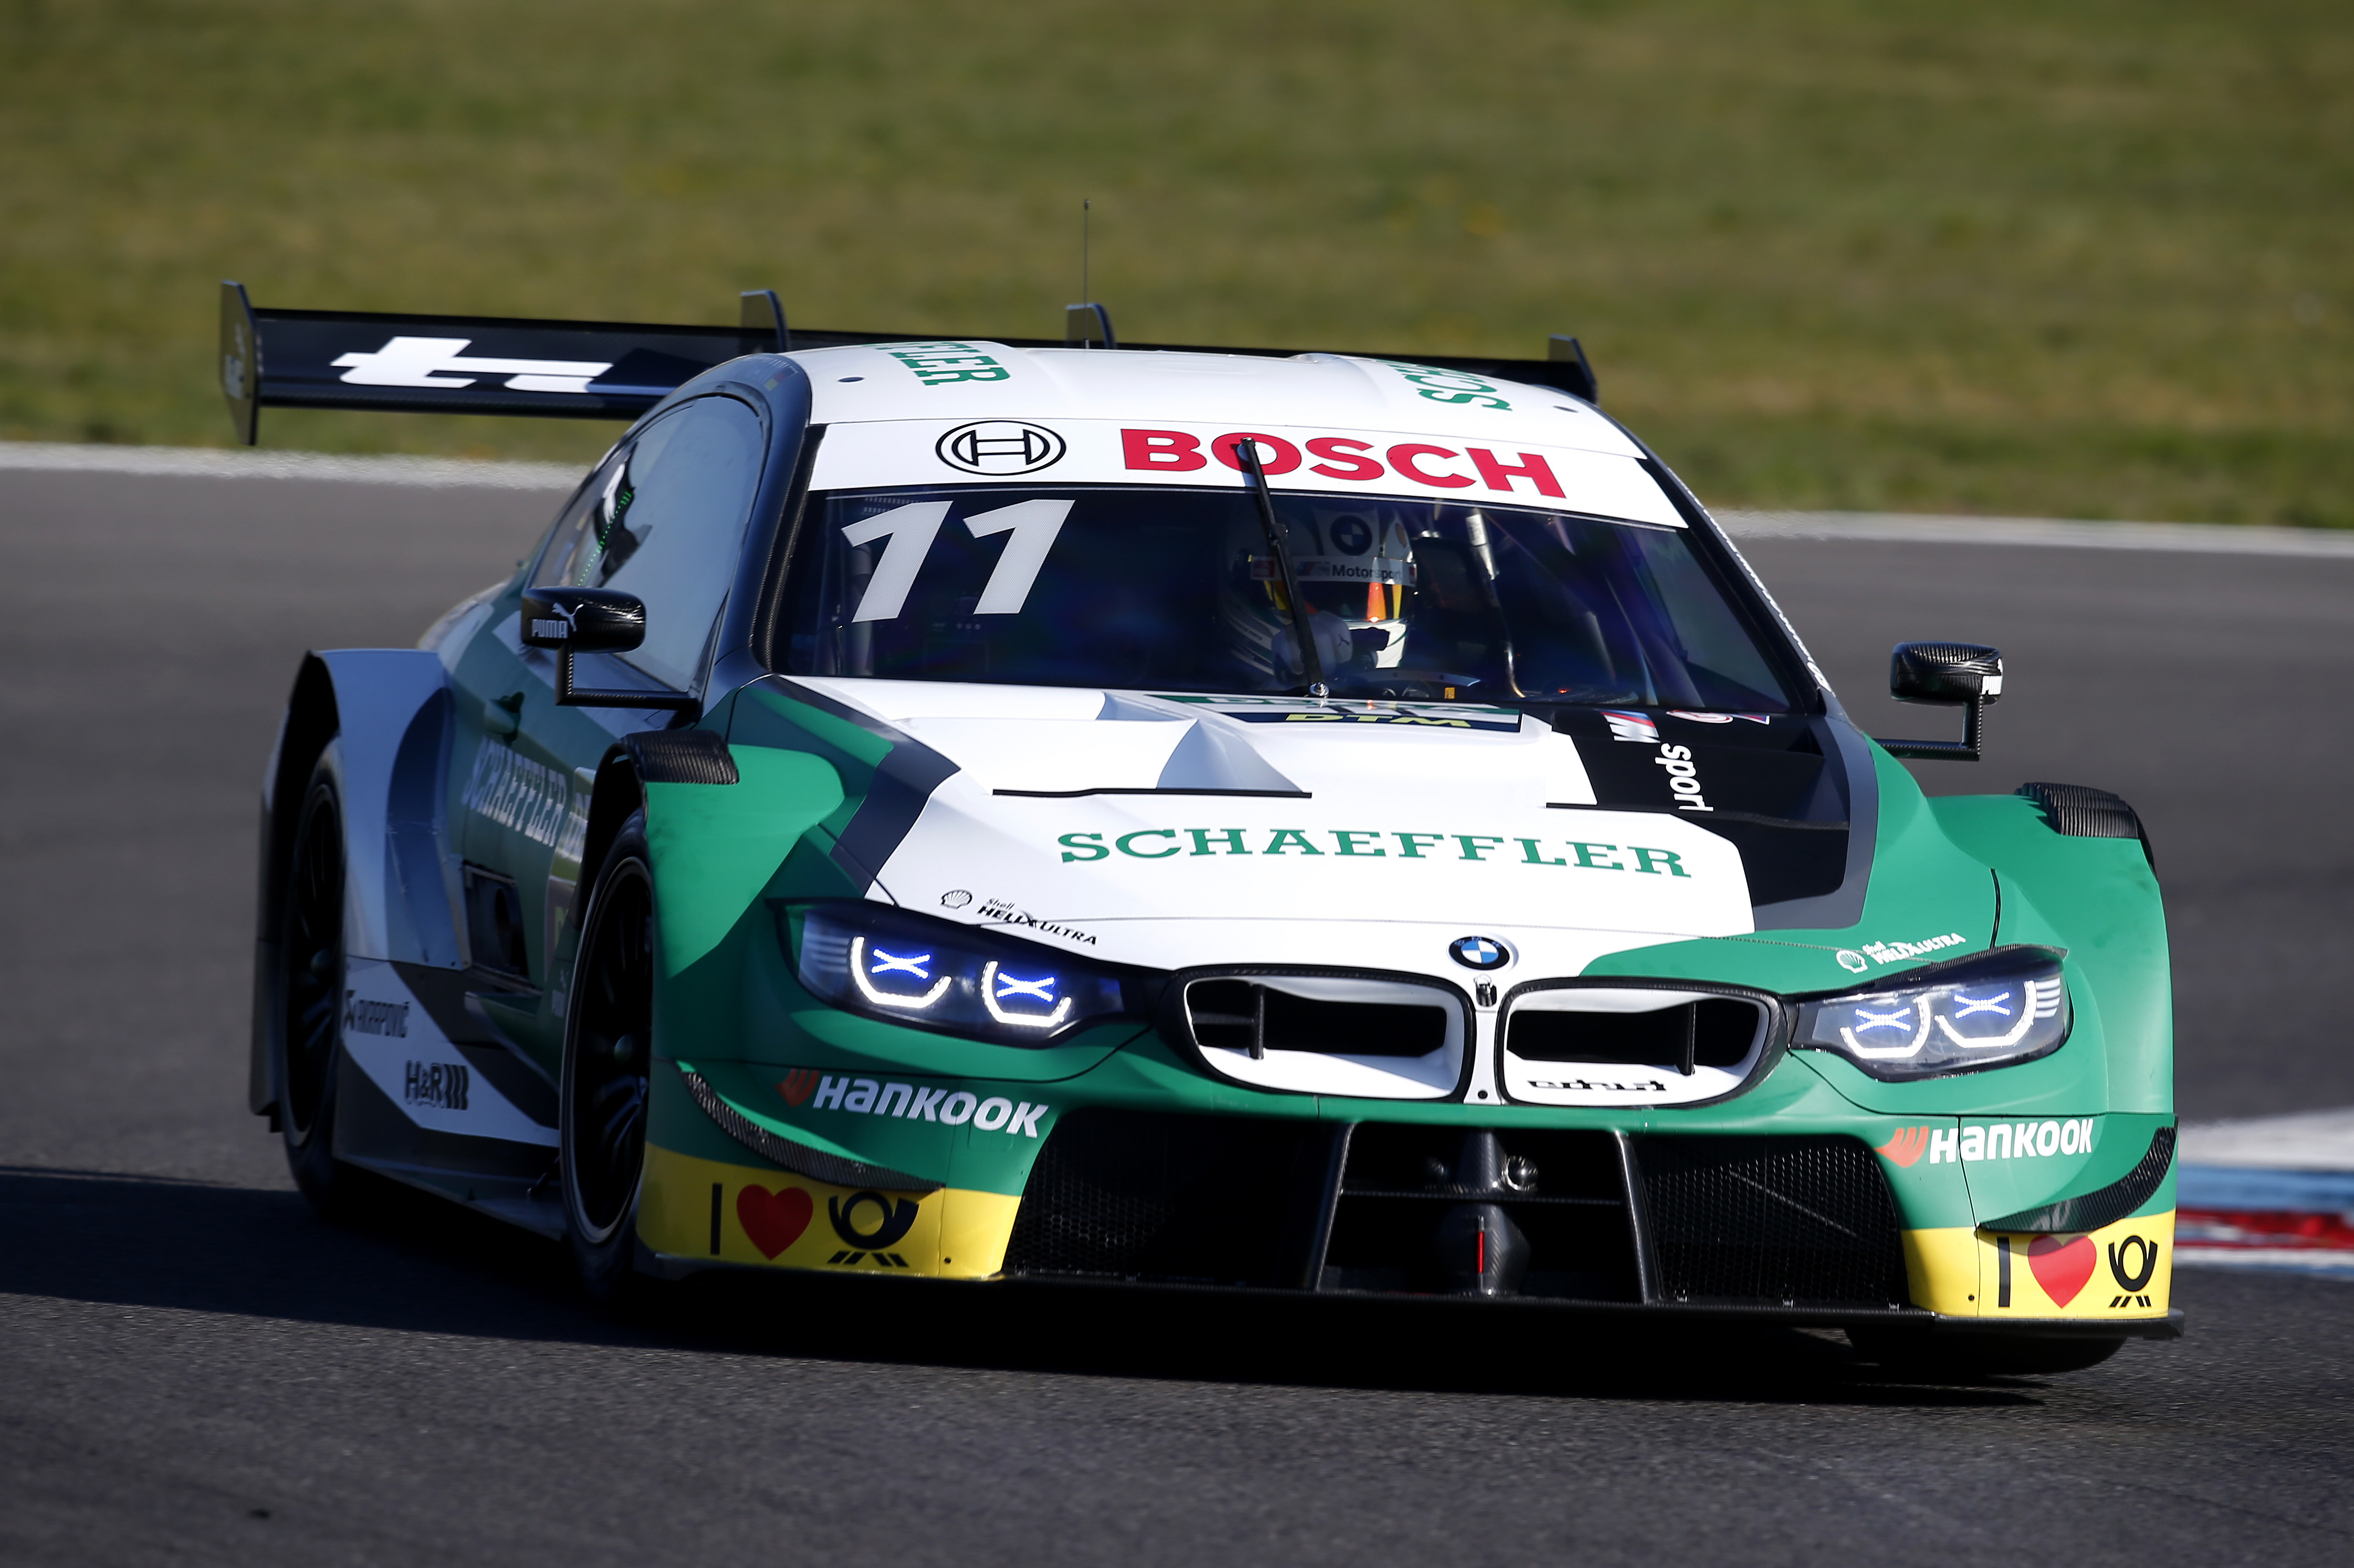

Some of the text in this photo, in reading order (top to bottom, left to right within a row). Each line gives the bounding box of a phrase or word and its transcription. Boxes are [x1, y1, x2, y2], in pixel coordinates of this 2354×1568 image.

[1120, 428, 1567, 499] BOSCH
[841, 499, 1076, 623] 11
[1285, 713, 1471, 728] DTM
[1655, 742, 1714, 812] sport
[1057, 828, 1692, 878] SCHAEFFLER
[976, 906, 1097, 945] HELIX ULTRA
[987, 898, 1015, 910] Shell
